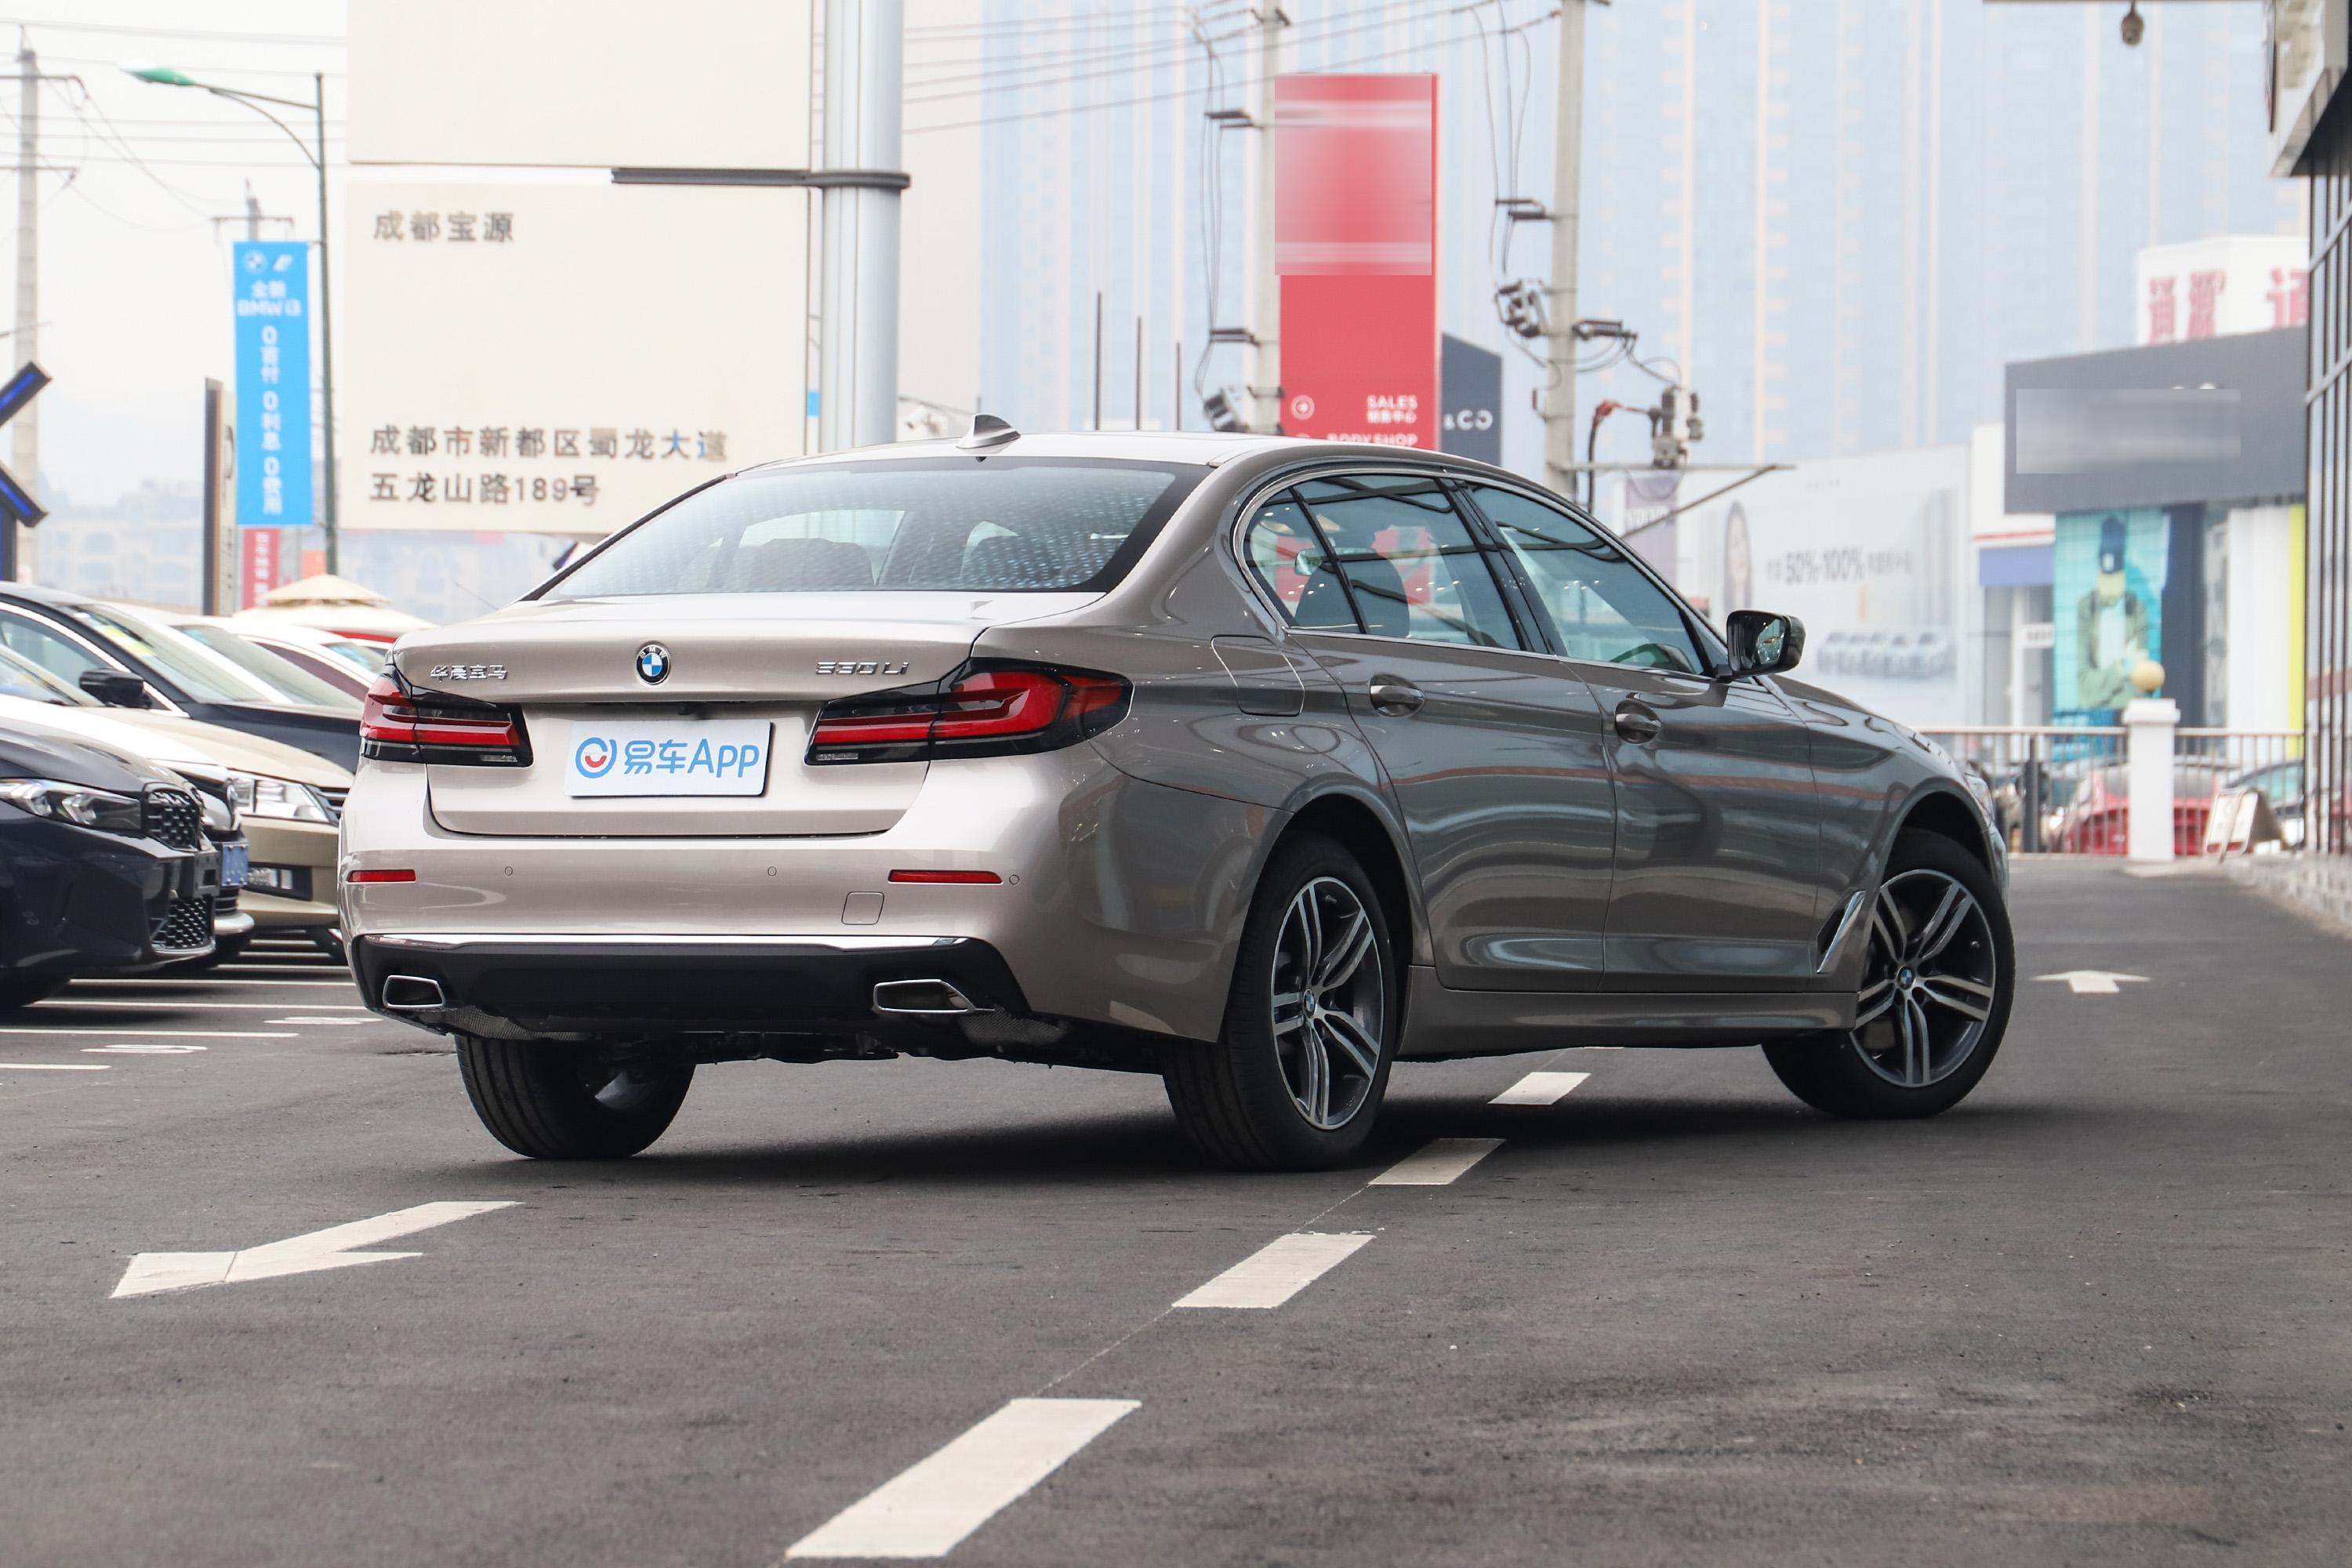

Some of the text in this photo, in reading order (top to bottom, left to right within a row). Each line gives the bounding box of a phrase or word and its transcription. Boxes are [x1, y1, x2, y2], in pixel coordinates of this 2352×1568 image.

[375, 210, 514, 242] 成都宝源
[238, 299, 282, 316] BMW
[1367, 395, 1417, 409] SALES
[371, 424, 728, 463] 成都市新都区蜀龙大道
[370, 472, 601, 506] 五龙山路189号
[430, 665, 507, 683] 华晨宝马
[816, 662, 909, 675] 530 Li
[625, 739, 760, 778] 易车App
